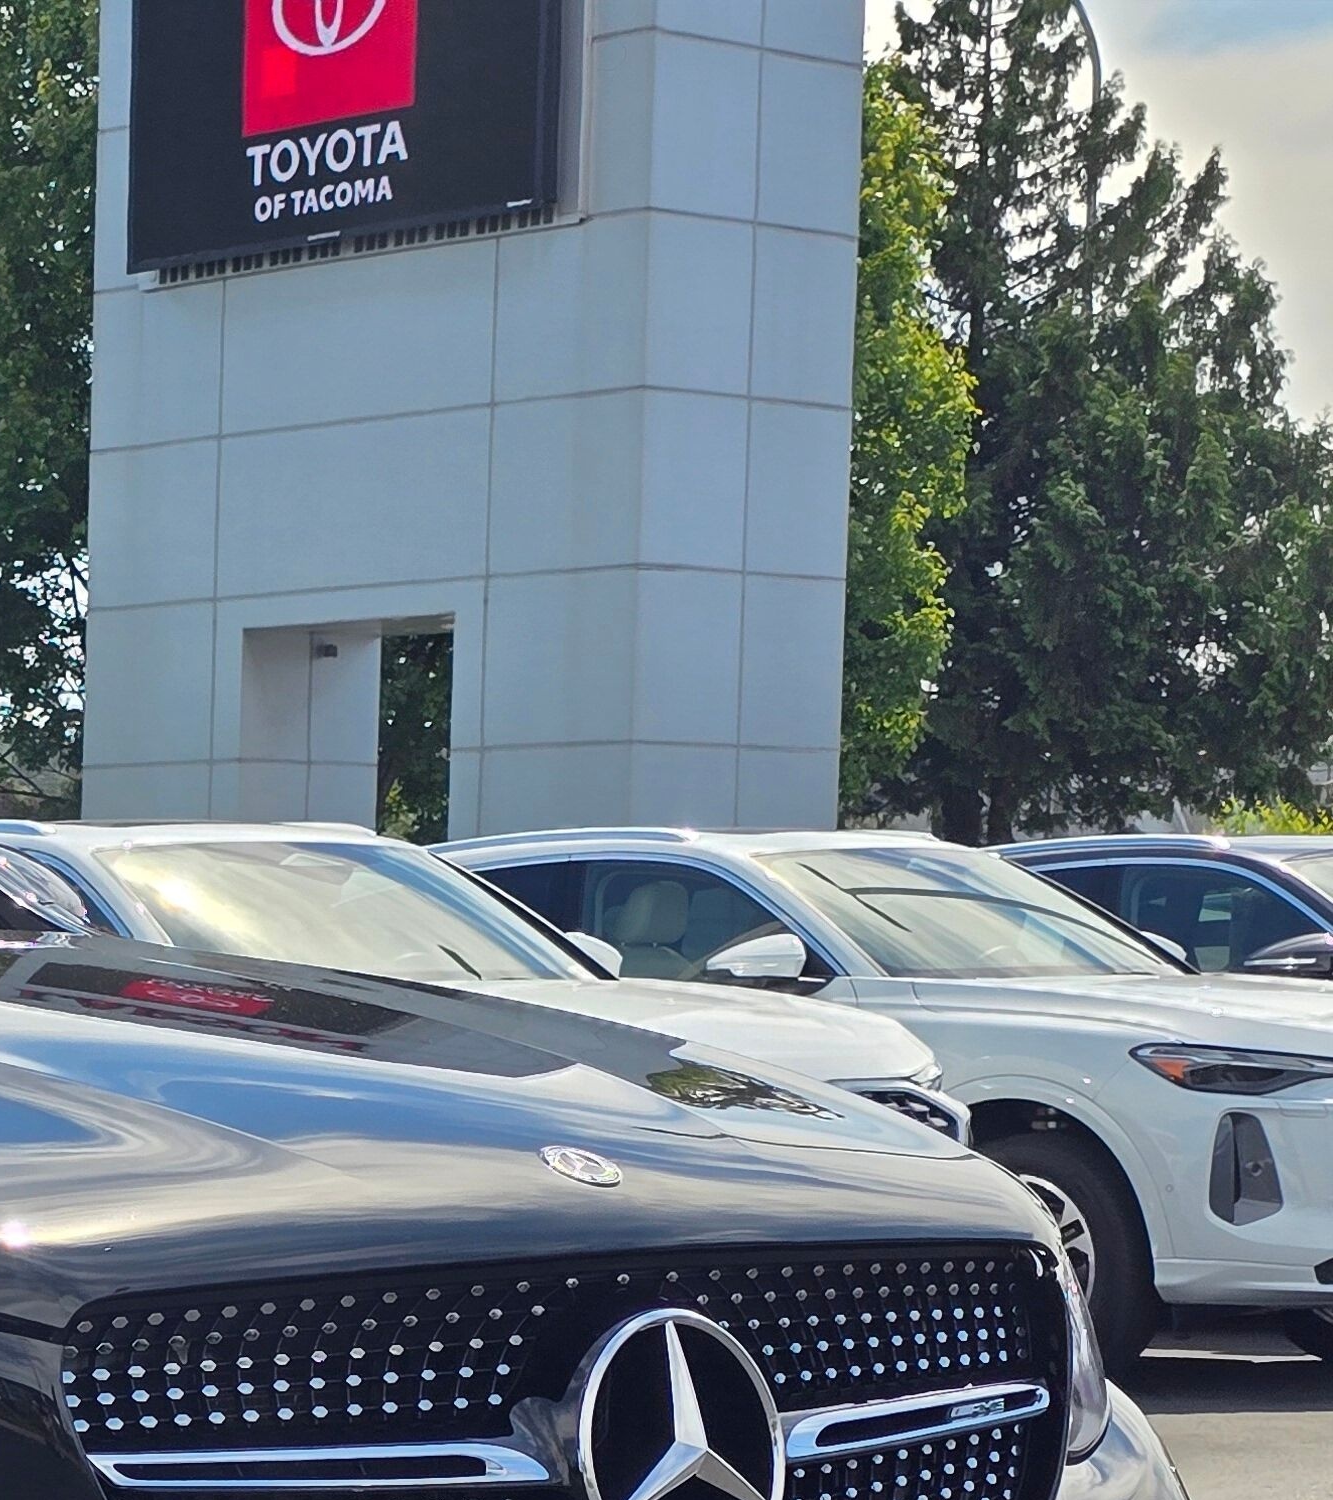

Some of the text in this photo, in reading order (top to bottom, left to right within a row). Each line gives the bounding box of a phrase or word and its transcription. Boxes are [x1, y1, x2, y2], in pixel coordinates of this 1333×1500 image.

[246, 120, 408, 186] TOYOTA
[254, 176, 393, 222] OF TACOMA
